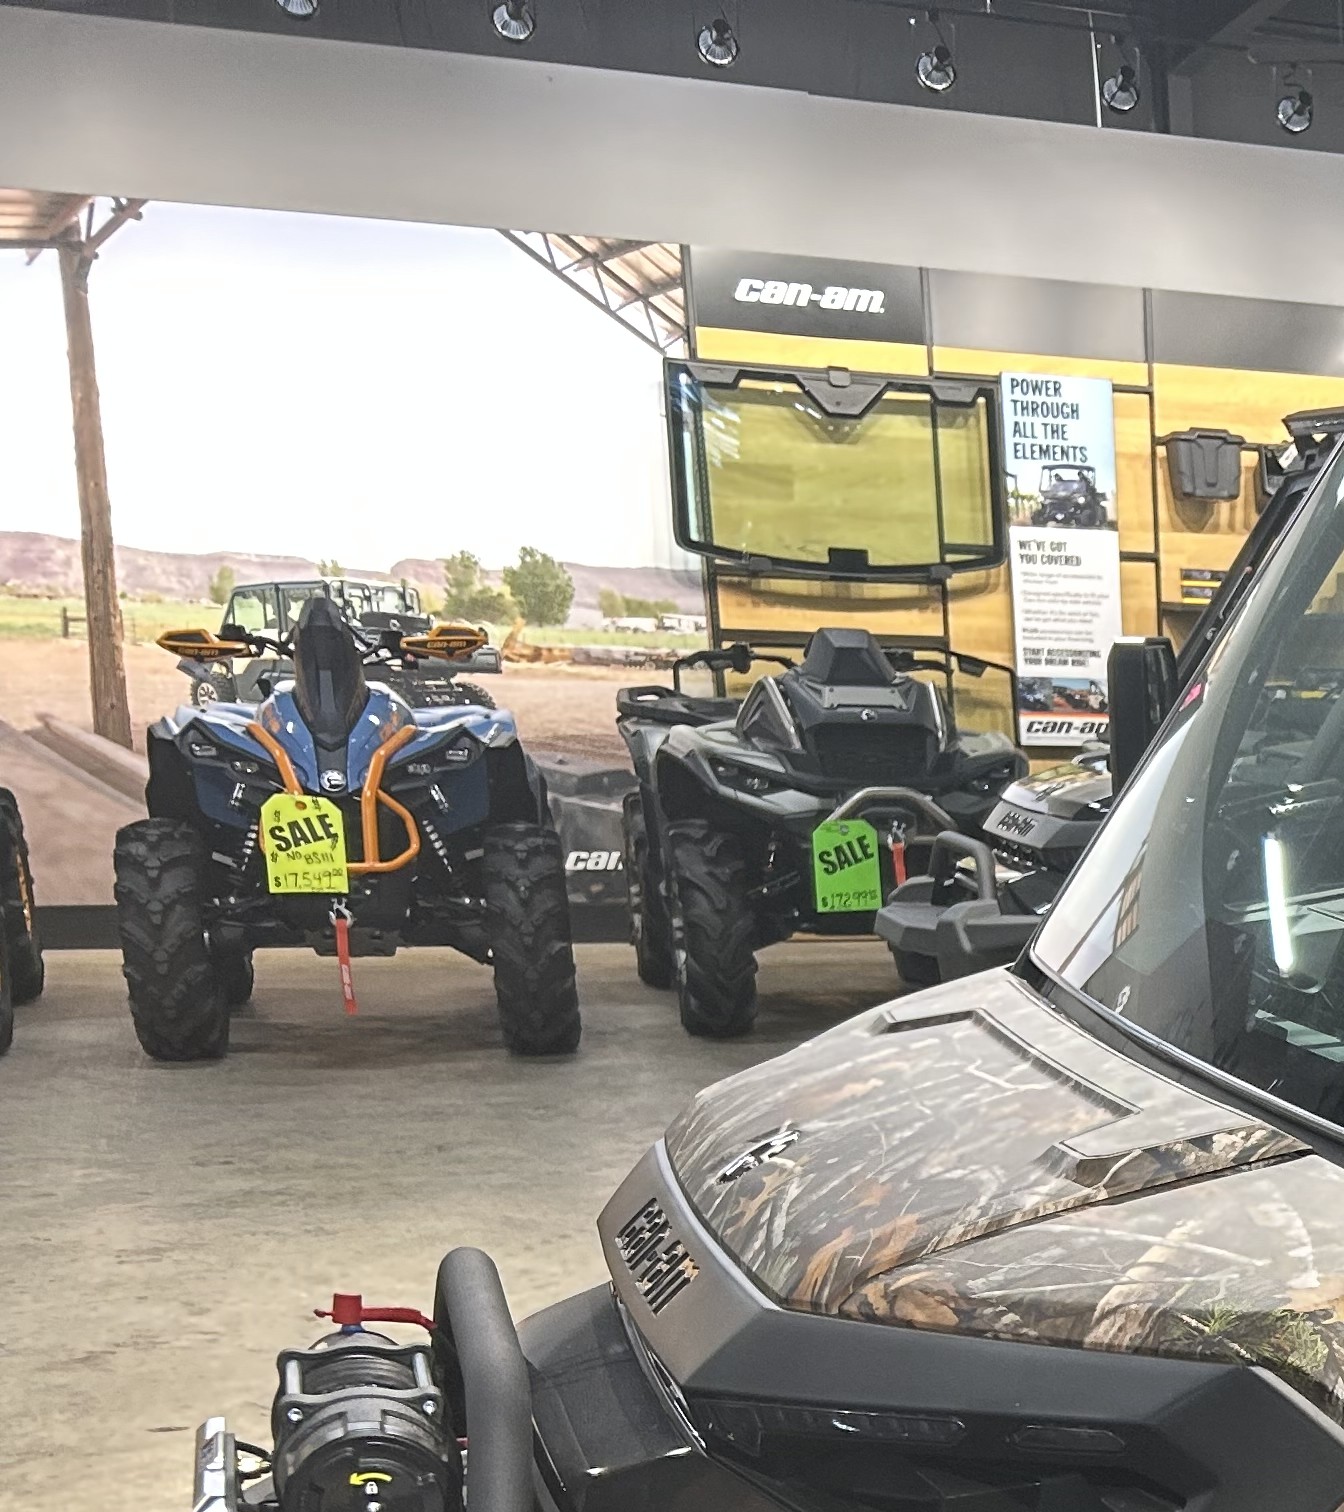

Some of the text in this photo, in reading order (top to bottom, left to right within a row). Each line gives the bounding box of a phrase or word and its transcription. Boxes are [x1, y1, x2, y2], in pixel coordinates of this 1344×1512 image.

[1010, 377, 1062, 398] POWER
[1010, 399, 1080, 420] THROUGH
[1012, 421, 1068, 441] ALL THE
[1013, 442, 1088, 463] ELEMENTS
[1050, 540, 1067, 552] GOT
[1019, 553, 1037, 565] YOU
[269, 813, 339, 852] SALE
[818, 834, 875, 876] SALE
